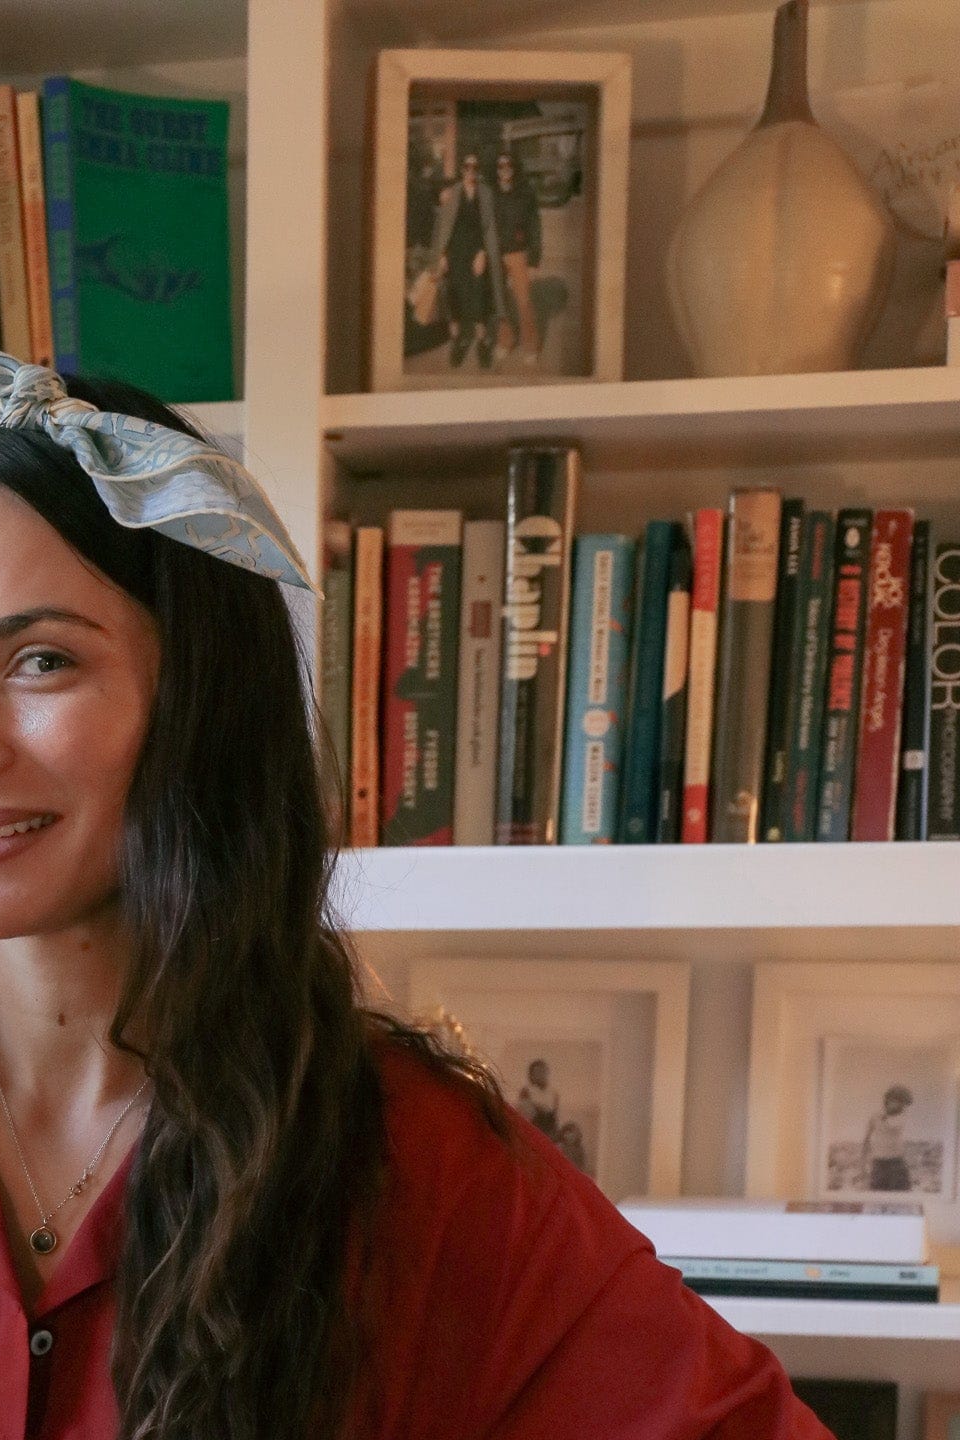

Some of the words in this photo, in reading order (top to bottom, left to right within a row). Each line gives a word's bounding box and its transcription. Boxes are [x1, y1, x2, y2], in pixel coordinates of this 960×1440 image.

[427, 565, 443, 593] THE
[502, 516, 562, 680] Chaplin
[932, 549, 960, 709] COLOR
[426, 599, 443, 680] BROTHERS
